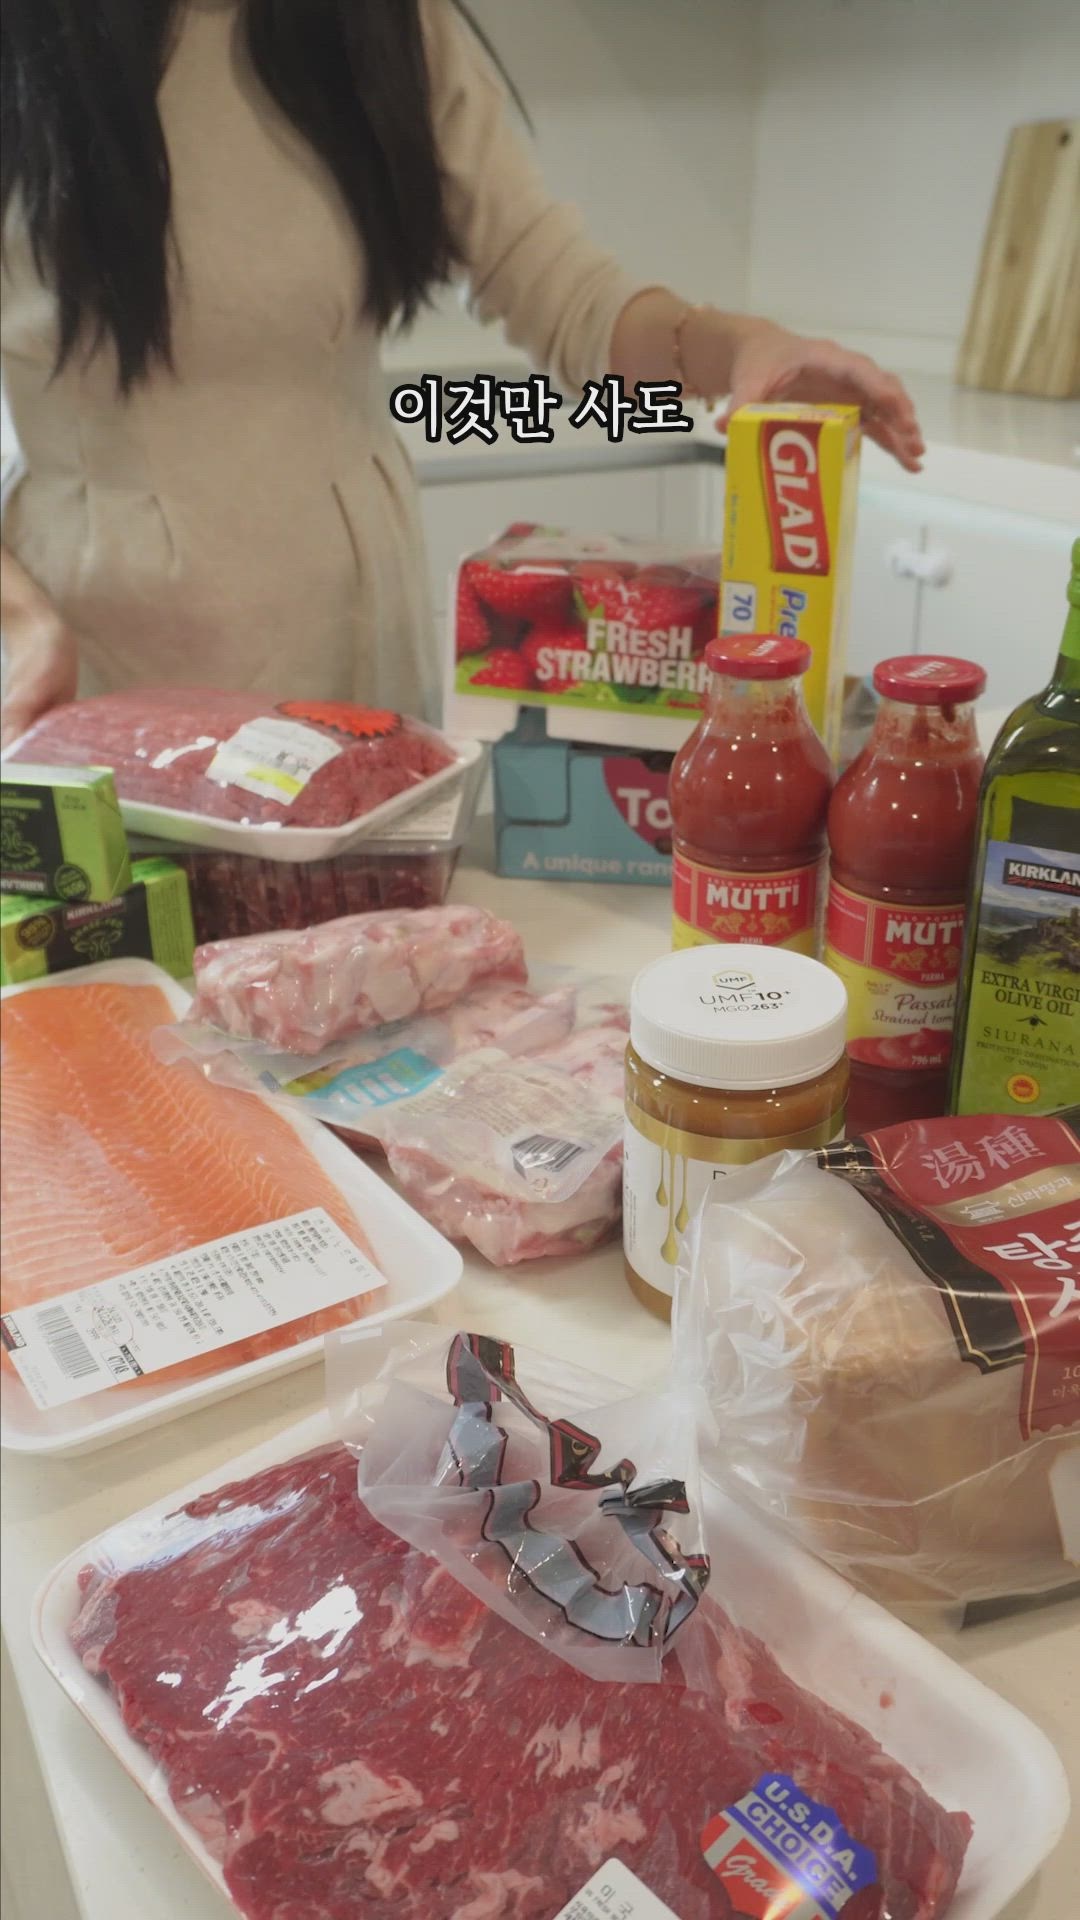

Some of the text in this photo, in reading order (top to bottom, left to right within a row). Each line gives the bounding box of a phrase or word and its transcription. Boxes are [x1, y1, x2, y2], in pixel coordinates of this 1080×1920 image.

[769, 429, 819, 569] GLAD
[732, 595, 752, 622] 70
[586, 617, 693, 660] FRESH
[522, 851, 541, 872] A
[543, 853, 624, 876] unique
[706, 883, 800, 911] MUTTI
[982, 971, 1031, 993] EXTRA
[995, 989, 1075, 1017] OLIVE OIL
[983, 1026, 1075, 1056] SIURANA
[921, 1125, 1047, 1189] 湯種
[1007, 1176, 1073, 1208] 신라명과
[765, 1781, 857, 1882] U.S.D.A.
[747, 1802, 845, 1900] CHOICE
